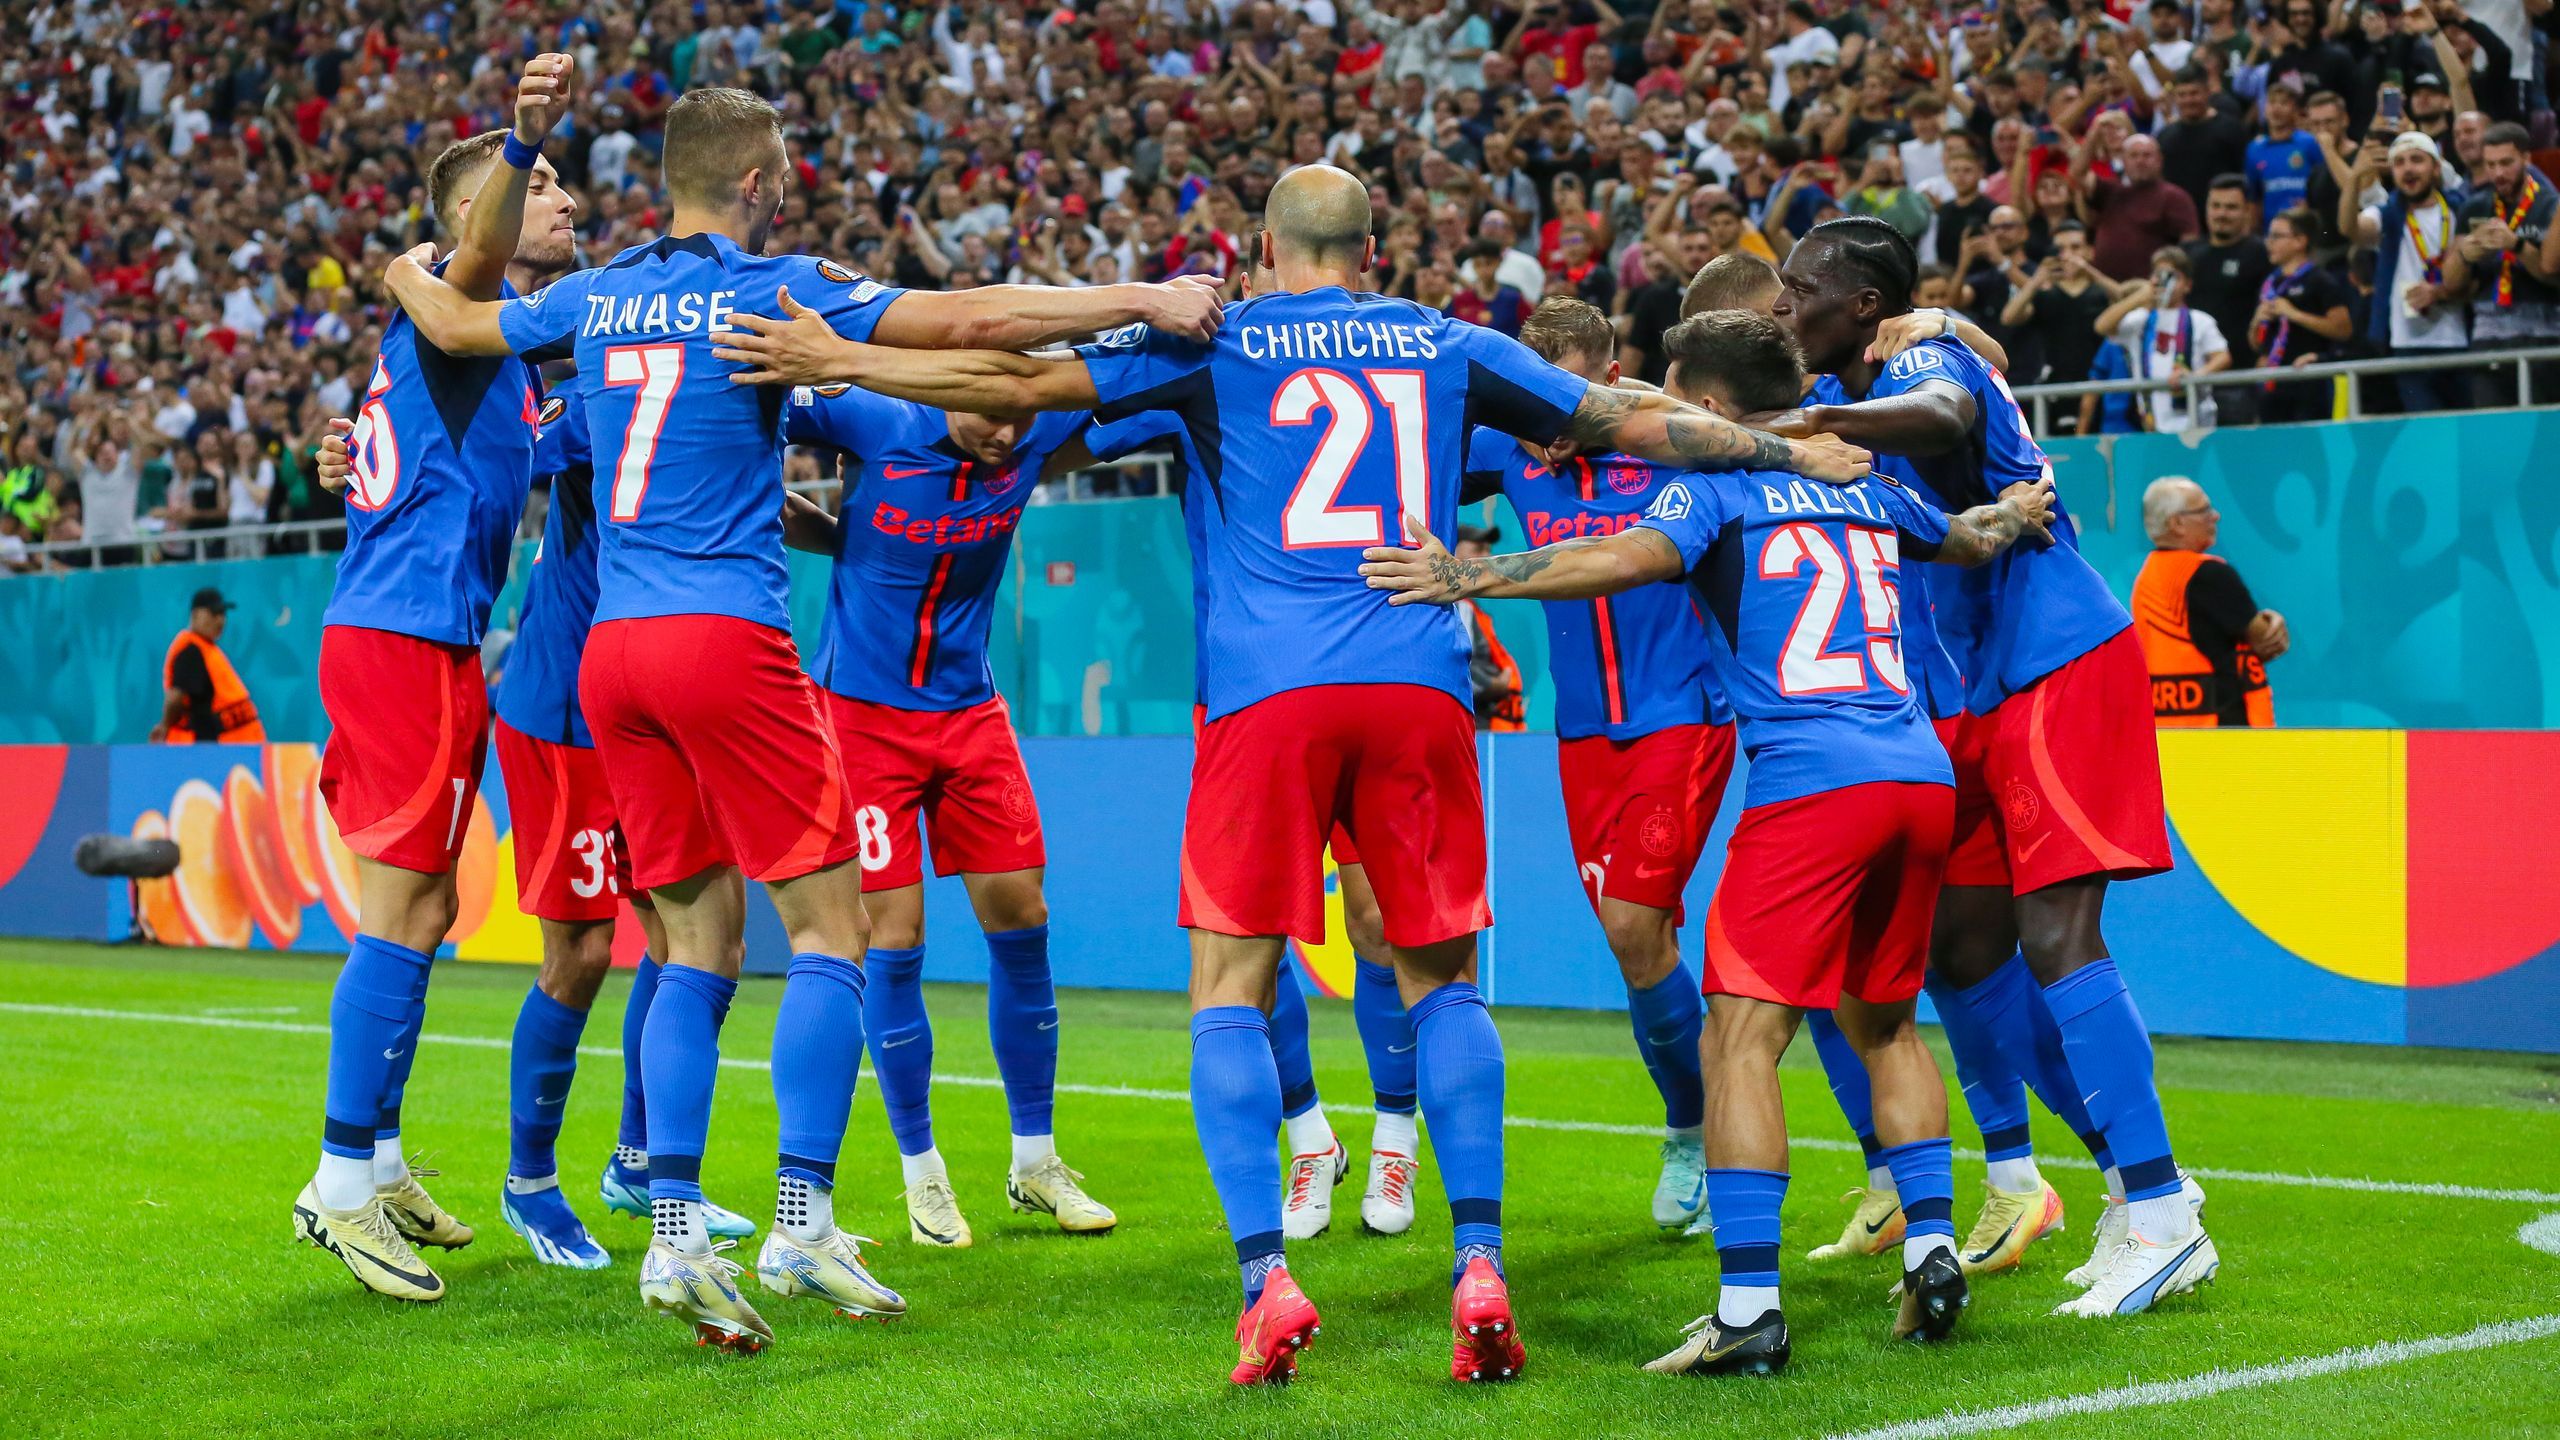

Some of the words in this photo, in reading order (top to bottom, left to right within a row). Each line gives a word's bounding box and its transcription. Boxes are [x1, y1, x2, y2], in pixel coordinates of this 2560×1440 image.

[582, 290, 736, 327] TANASE
[1241, 320, 1438, 360] CHIRICHES
[1890, 347, 1943, 381] MG
[604, 342, 686, 522] 7
[1270, 367, 1431, 551] 21
[872, 502, 1021, 545] Betano
[1527, 511, 1643, 547] Betan
[1758, 521, 1910, 697] 25
